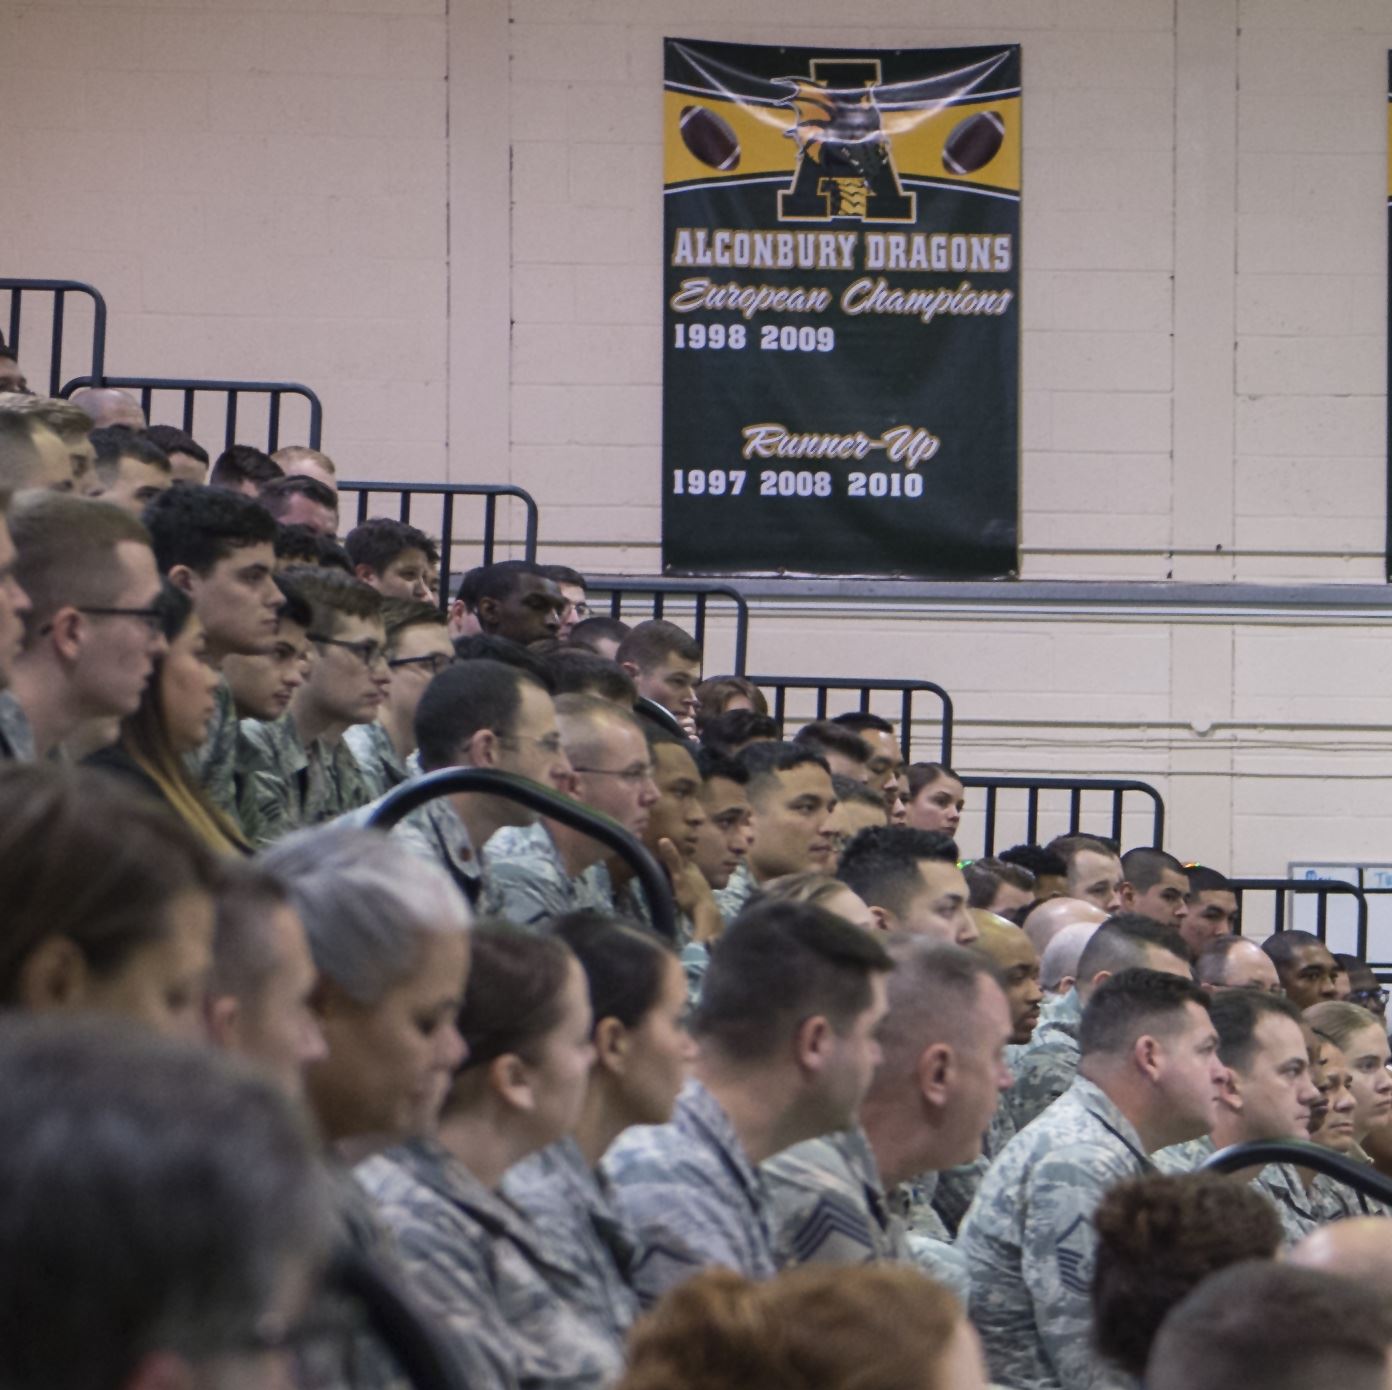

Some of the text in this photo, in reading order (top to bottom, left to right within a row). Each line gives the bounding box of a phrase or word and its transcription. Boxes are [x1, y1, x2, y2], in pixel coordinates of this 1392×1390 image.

[672, 228, 1012, 272] ALCONBURY DRAGONS
[670, 277, 1014, 324] European Champions
[674, 323, 835, 352] 1998 2009
[742, 422, 941, 470] Runner-Up
[673, 469, 923, 497] 1997 2008 2010
